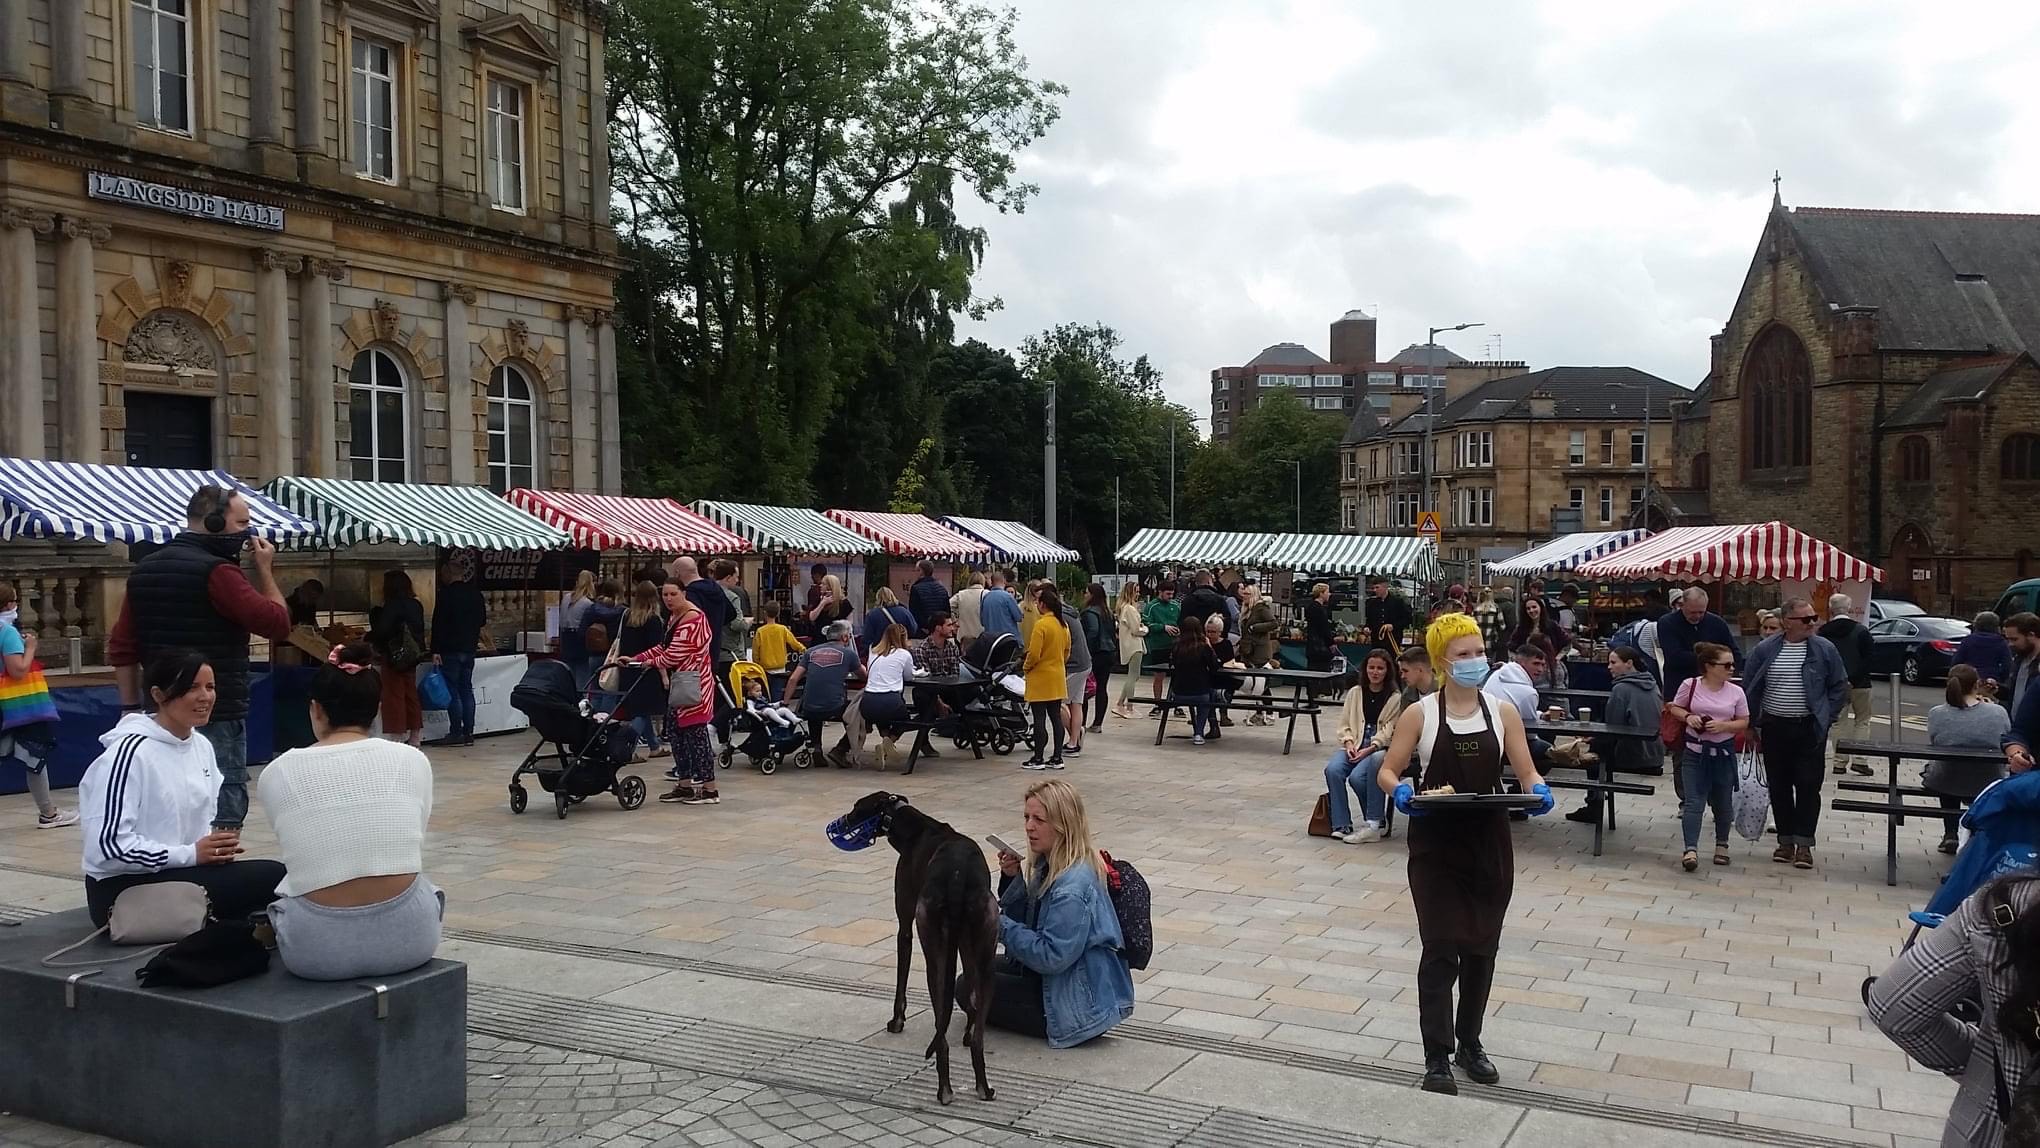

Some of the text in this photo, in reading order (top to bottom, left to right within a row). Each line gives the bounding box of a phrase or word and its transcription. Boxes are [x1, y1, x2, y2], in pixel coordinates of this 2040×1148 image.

[98, 175, 281, 226] LANGSIDE HALL
[484, 565, 538, 580] CHEESE
